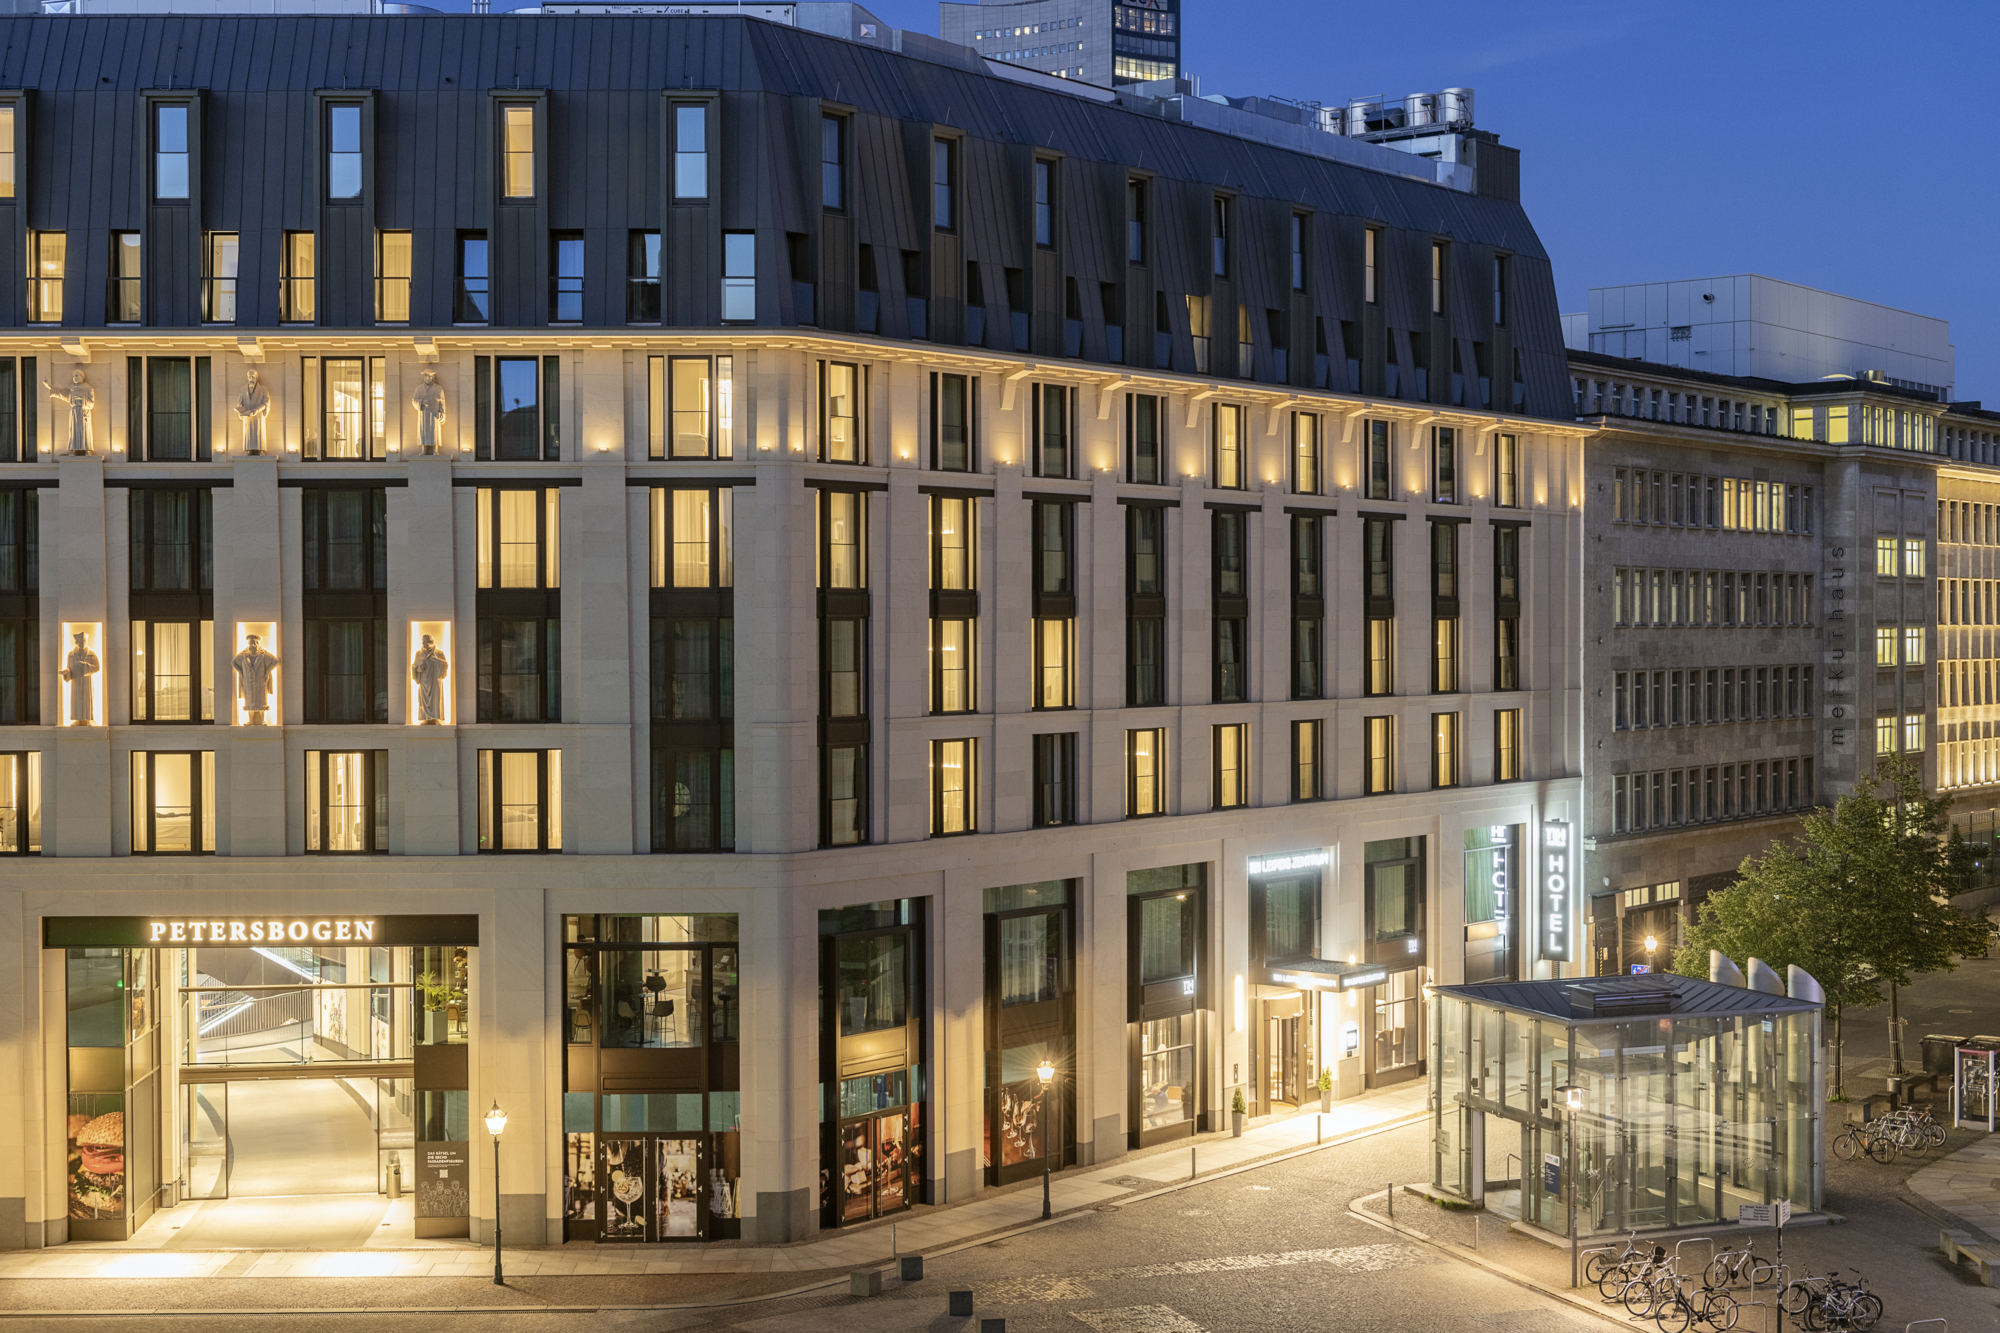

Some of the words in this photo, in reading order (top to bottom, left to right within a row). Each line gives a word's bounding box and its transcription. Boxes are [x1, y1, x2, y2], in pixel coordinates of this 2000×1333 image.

[1828, 546, 1845, 745] merkurhaus
[1292, 852, 1329, 869] ZENTRUM
[150, 921, 375, 941] PETERSBOGEN
[1547, 854, 1565, 952] HOTEL
